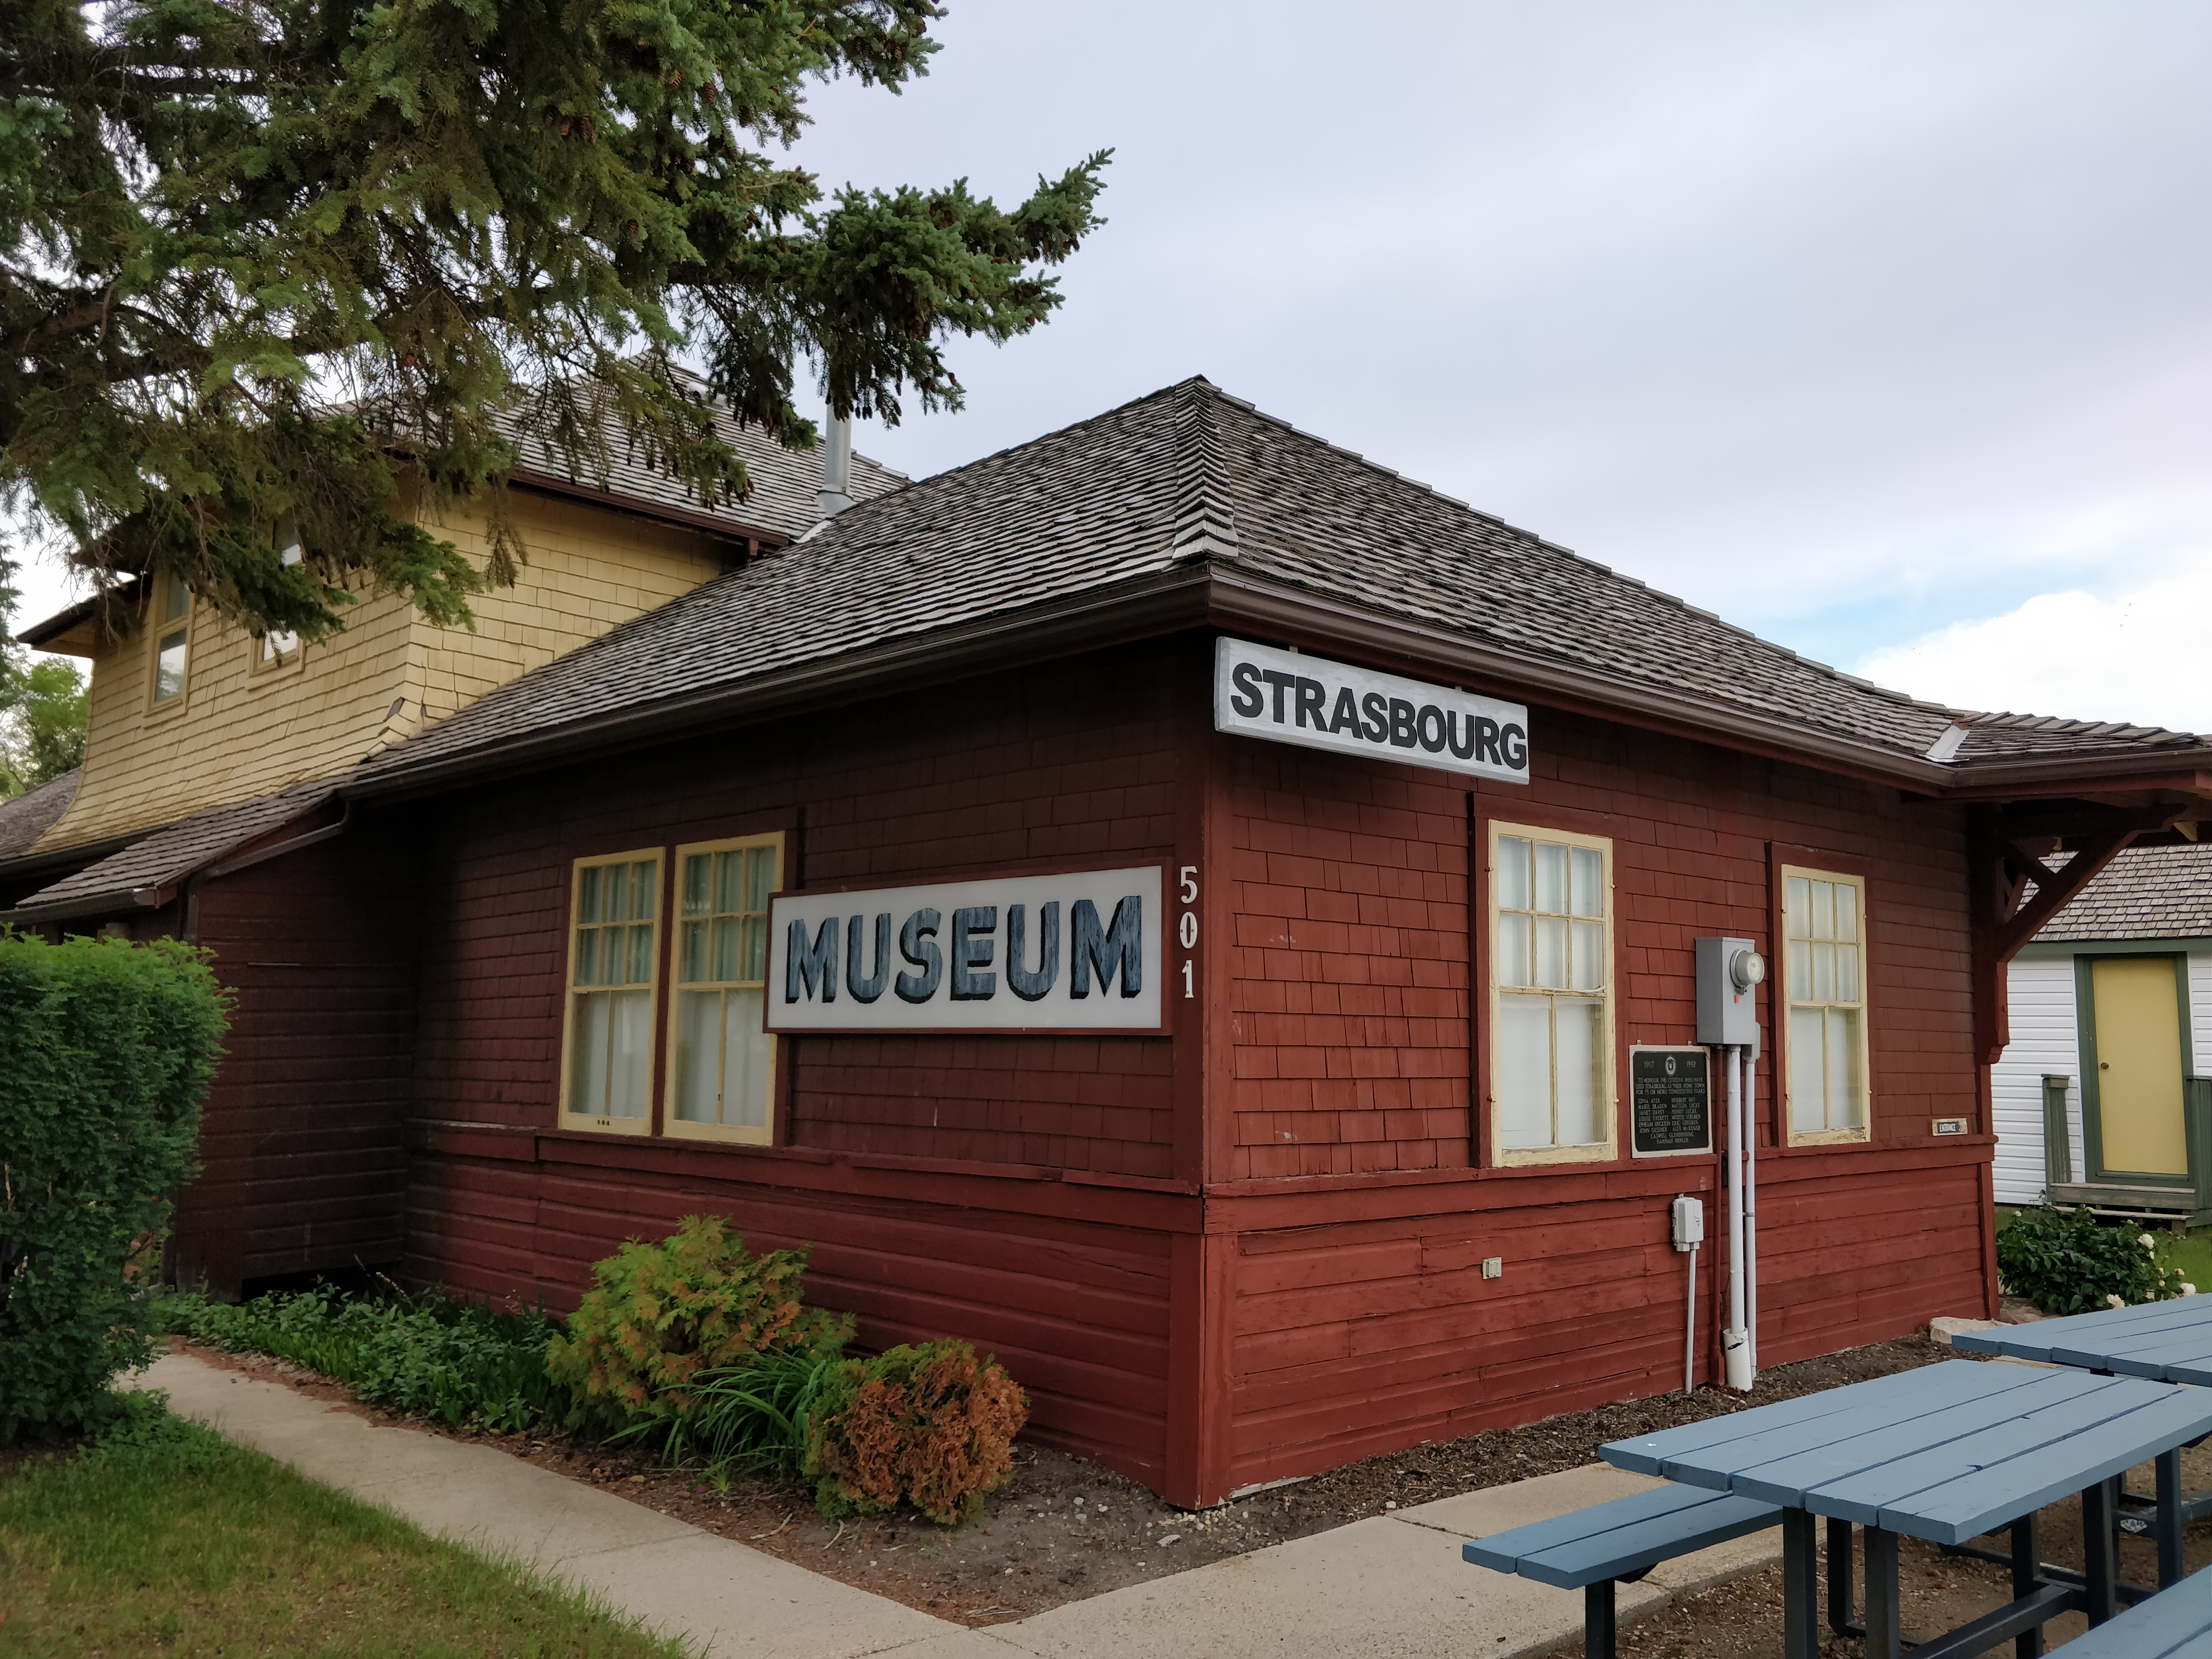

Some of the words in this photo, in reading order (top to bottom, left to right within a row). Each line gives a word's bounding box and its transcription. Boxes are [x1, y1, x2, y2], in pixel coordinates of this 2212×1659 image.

[1230, 662, 1527, 770] STRASBOURG
[785, 895, 1142, 1004] MUSEUM
[1179, 866, 1198, 999] 501
